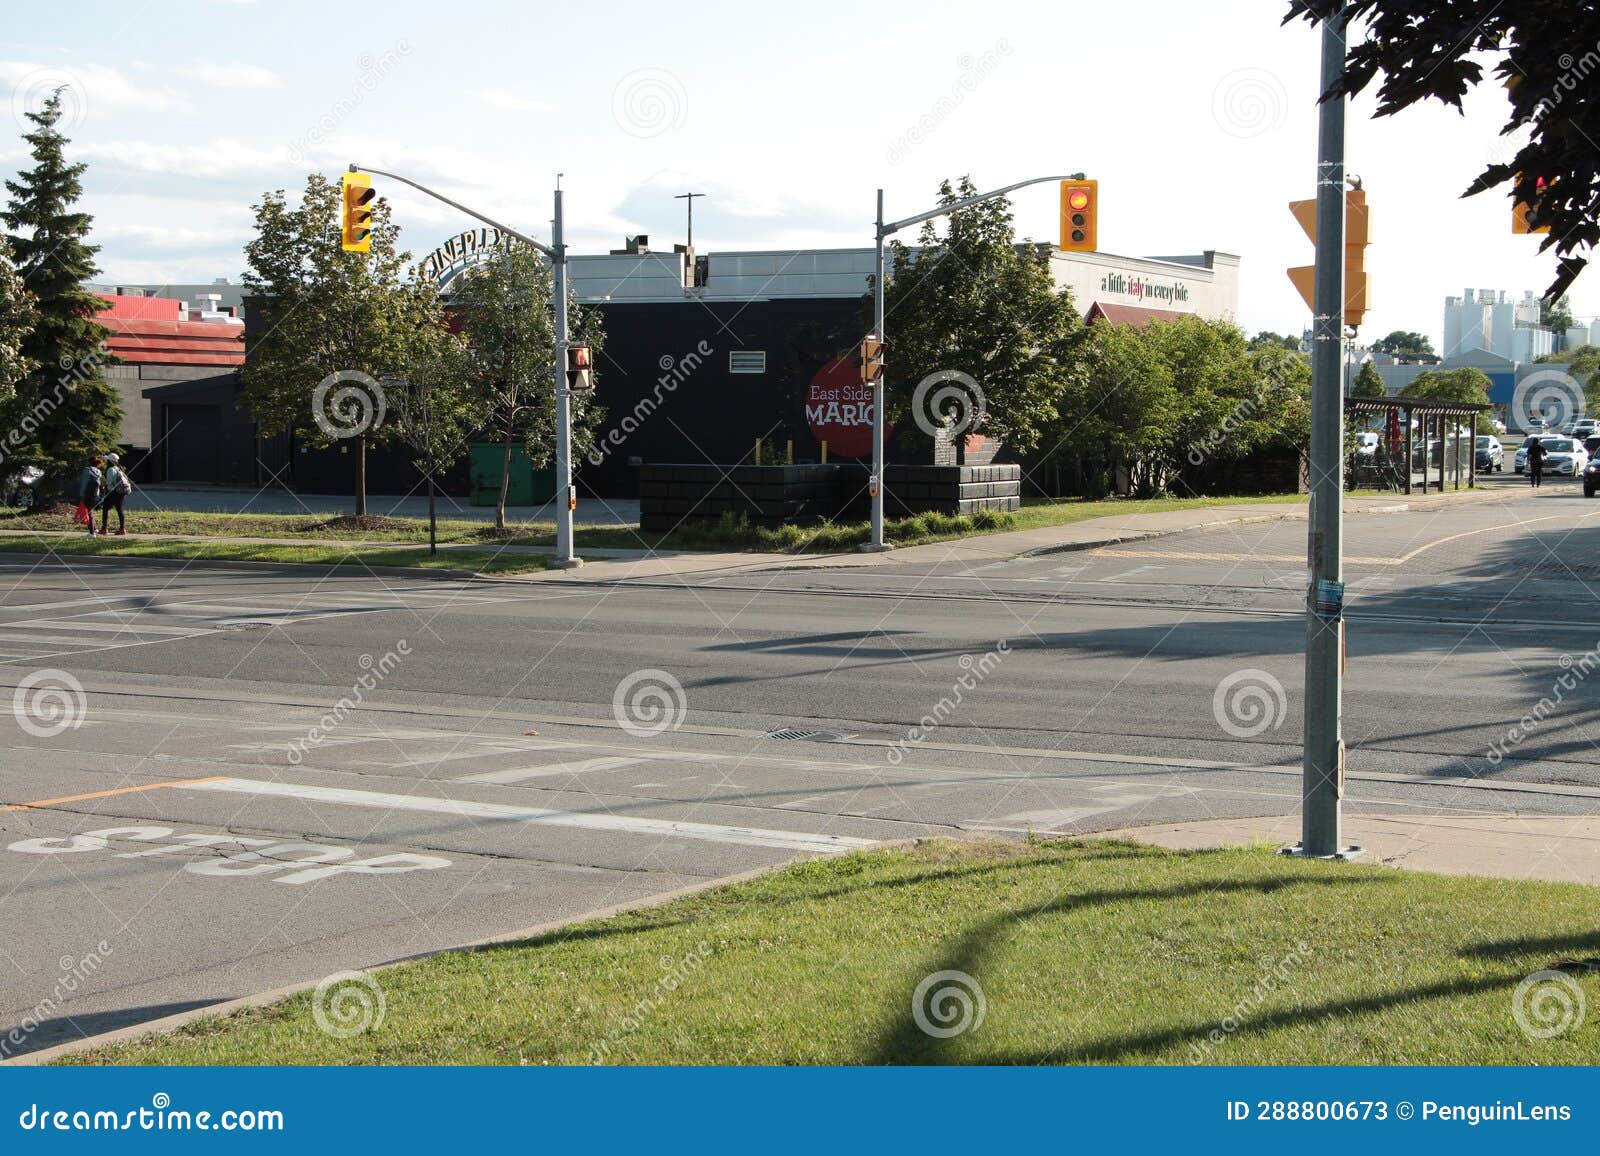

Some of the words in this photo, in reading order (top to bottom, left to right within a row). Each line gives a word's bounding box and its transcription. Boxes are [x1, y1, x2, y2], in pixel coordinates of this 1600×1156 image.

[1101, 277, 1107, 292] a
[1108, 272, 1127, 294] little
[1128, 275, 1144, 302] italy
[1145, 278, 1153, 298] in
[1154, 284, 1174, 305] every
[1174, 282, 1189, 302] bite
[811, 385, 840, 401] East
[843, 385, 872, 401] Side
[7, 826, 452, 885] STOP
